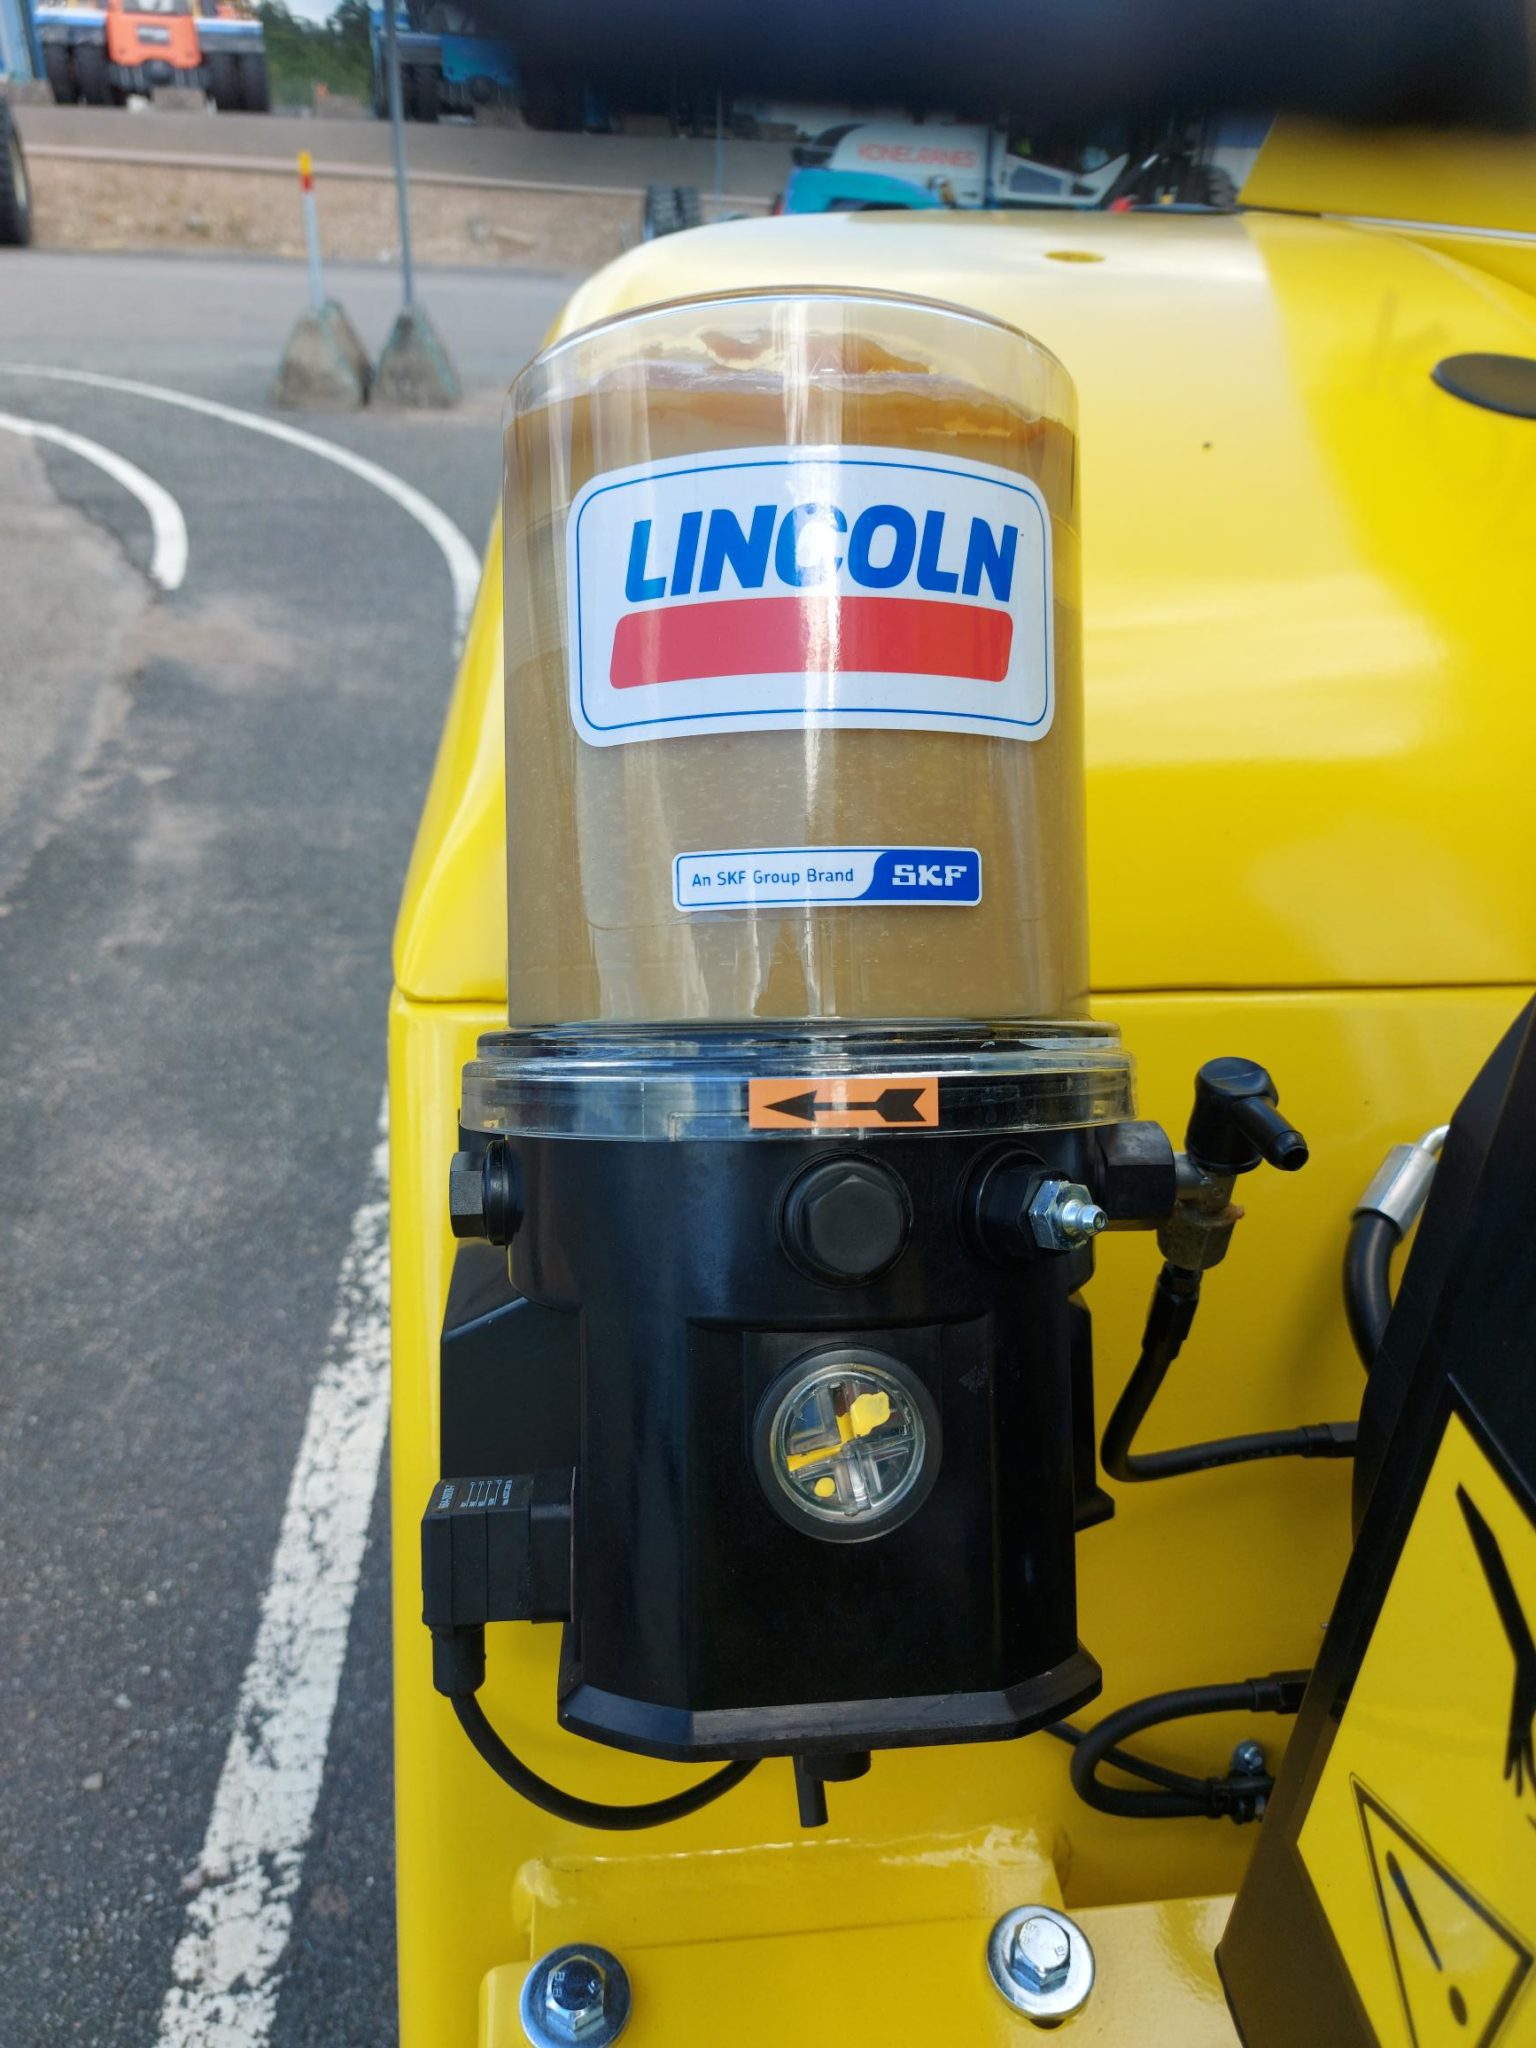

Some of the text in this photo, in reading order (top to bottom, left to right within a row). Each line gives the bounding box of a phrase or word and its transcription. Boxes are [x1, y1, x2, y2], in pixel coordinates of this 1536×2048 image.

[625, 503, 1018, 602] LINCOLN
[691, 867, 854, 887] An SKF Group Brand
[892, 864, 967, 887] SKF
